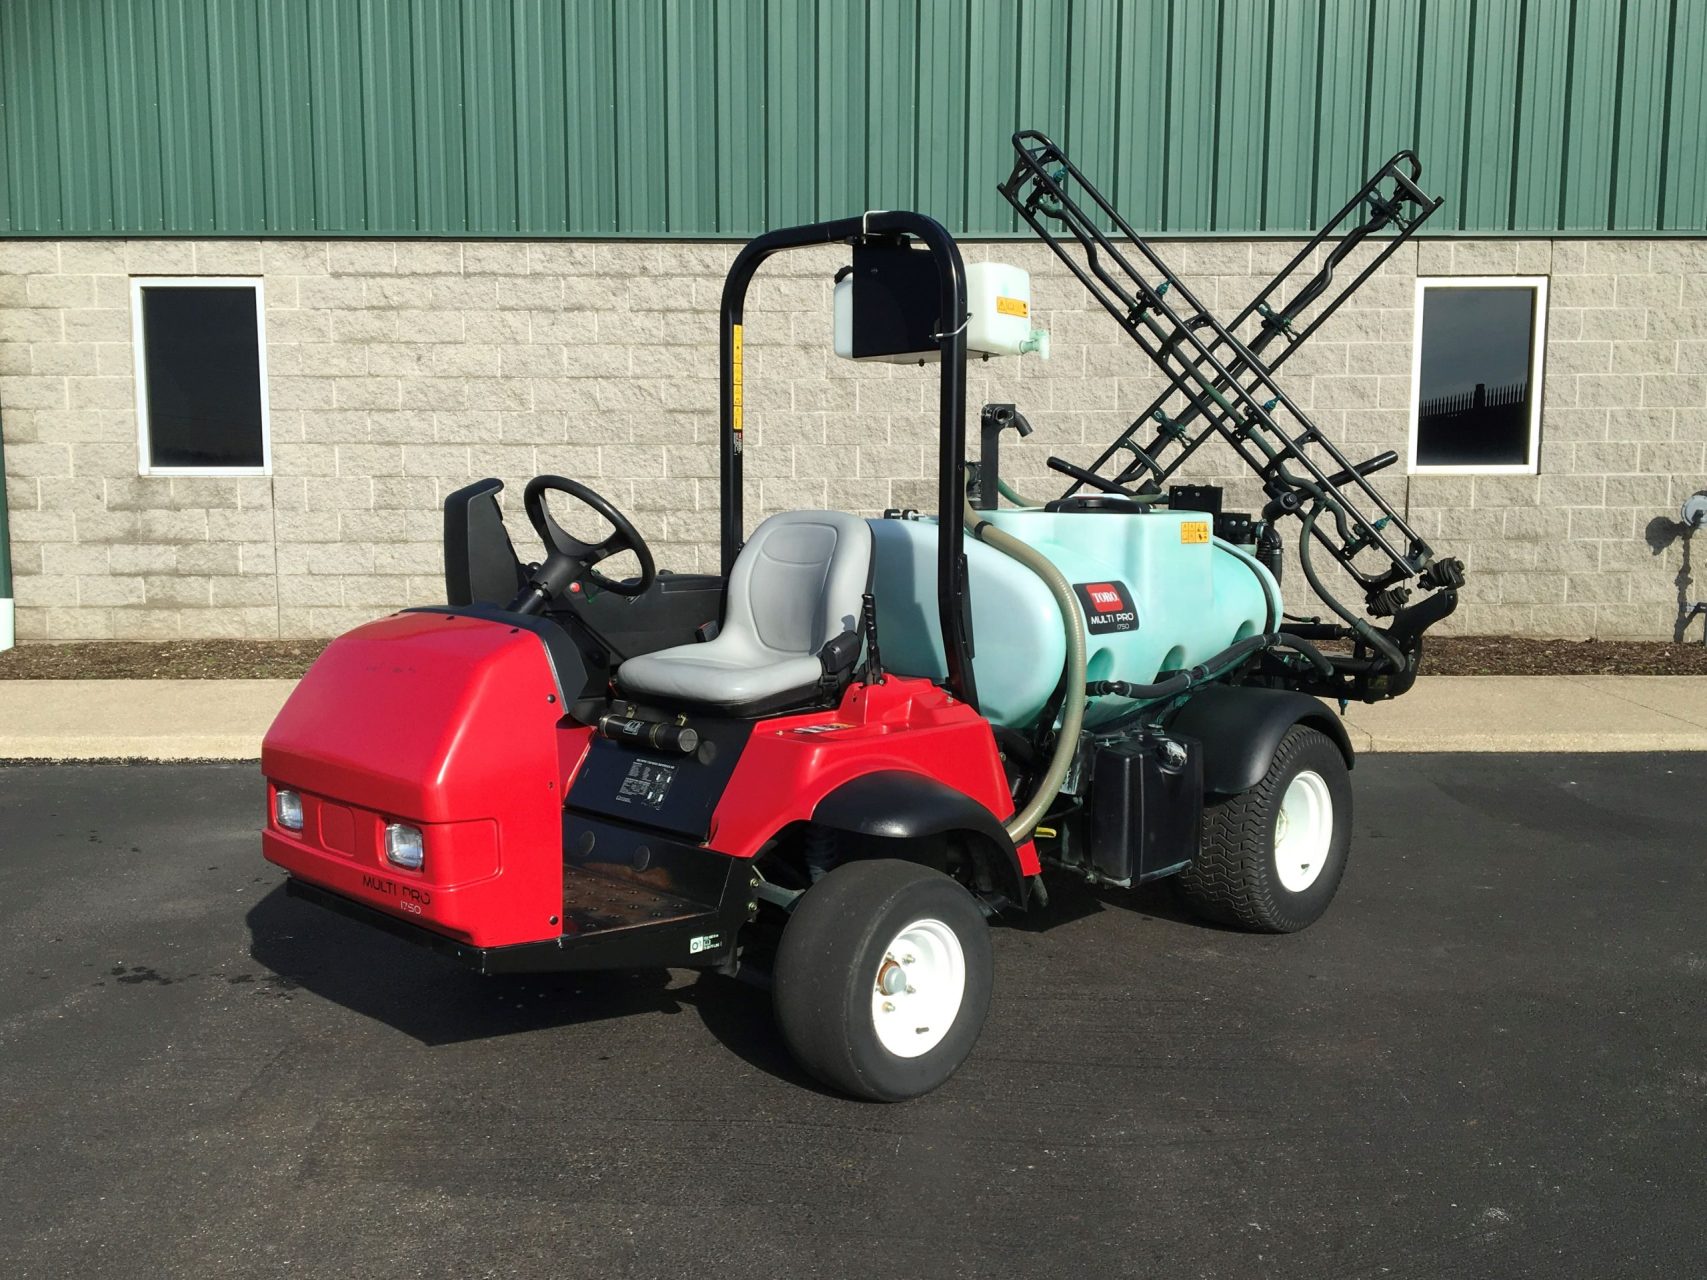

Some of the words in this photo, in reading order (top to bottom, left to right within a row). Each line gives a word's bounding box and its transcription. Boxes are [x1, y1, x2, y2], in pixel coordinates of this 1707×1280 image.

[1091, 591, 1120, 603] TORO
[1090, 614, 1115, 625] MULTI
[1115, 612, 1134, 622] PRO
[363, 874, 396, 896] MULTI
[402, 886, 431, 905] PRO
[400, 900, 422, 915] 1750
